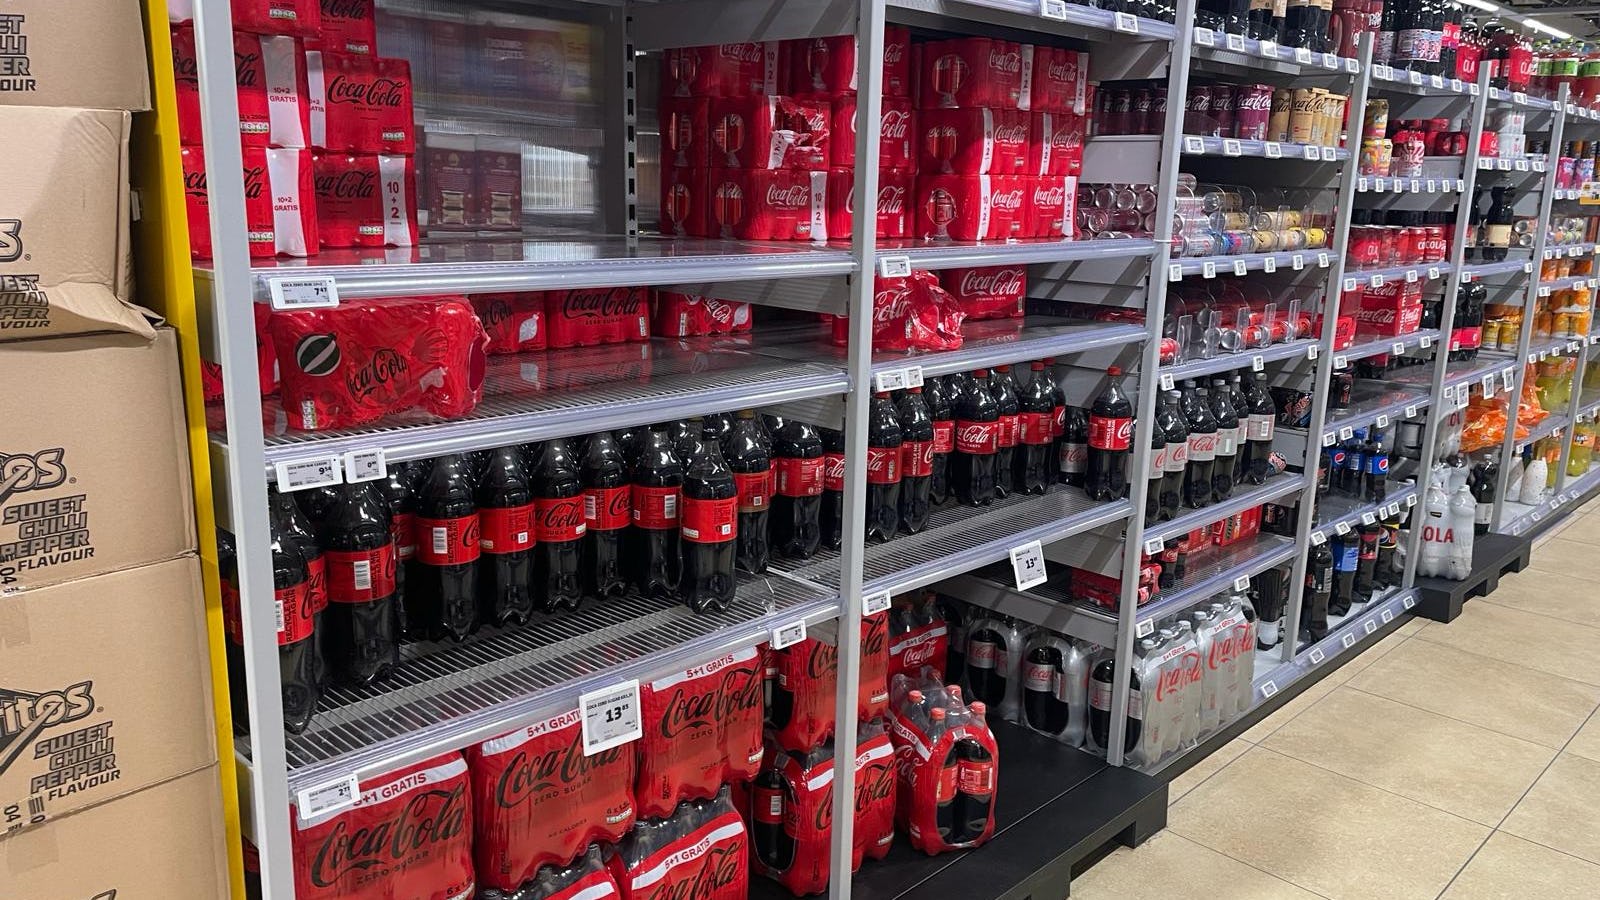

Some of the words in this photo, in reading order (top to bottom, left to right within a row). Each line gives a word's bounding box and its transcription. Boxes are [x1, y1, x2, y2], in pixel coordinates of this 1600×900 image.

[0, 56, 31, 76] ER
[0, 79, 36, 91] OUR
[386, 181, 399, 194] 10
[391, 207, 400, 219] 2
[0, 320, 50, 329] VOUR
[2, 494, 87, 525] SWEET
[19, 512, 88, 540] CHILLI
[1421, 525, 1455, 543] OLA
[17, 547, 95, 572] FLAVOUR
[686, 666, 704, 679] 5+1
[705, 654, 735, 673] GRATIS
[527, 722, 547, 737] 5+1
[549, 710, 582, 729] GRATI
[33, 721, 114, 760] SWEET
[49, 737, 115, 772] CHILLI
[31, 753, 116, 794] PEPPER
[48, 769, 121, 801] FLAVOUR
[382, 772, 428, 799] GRATIS
[563, 776, 593, 795] SUGAR
[311, 781, 466, 888] Coca-Cola
[664, 854, 681, 871] 5+1
[680, 837, 711, 861] GRATIS
[356, 869, 390, 885] ZERO
